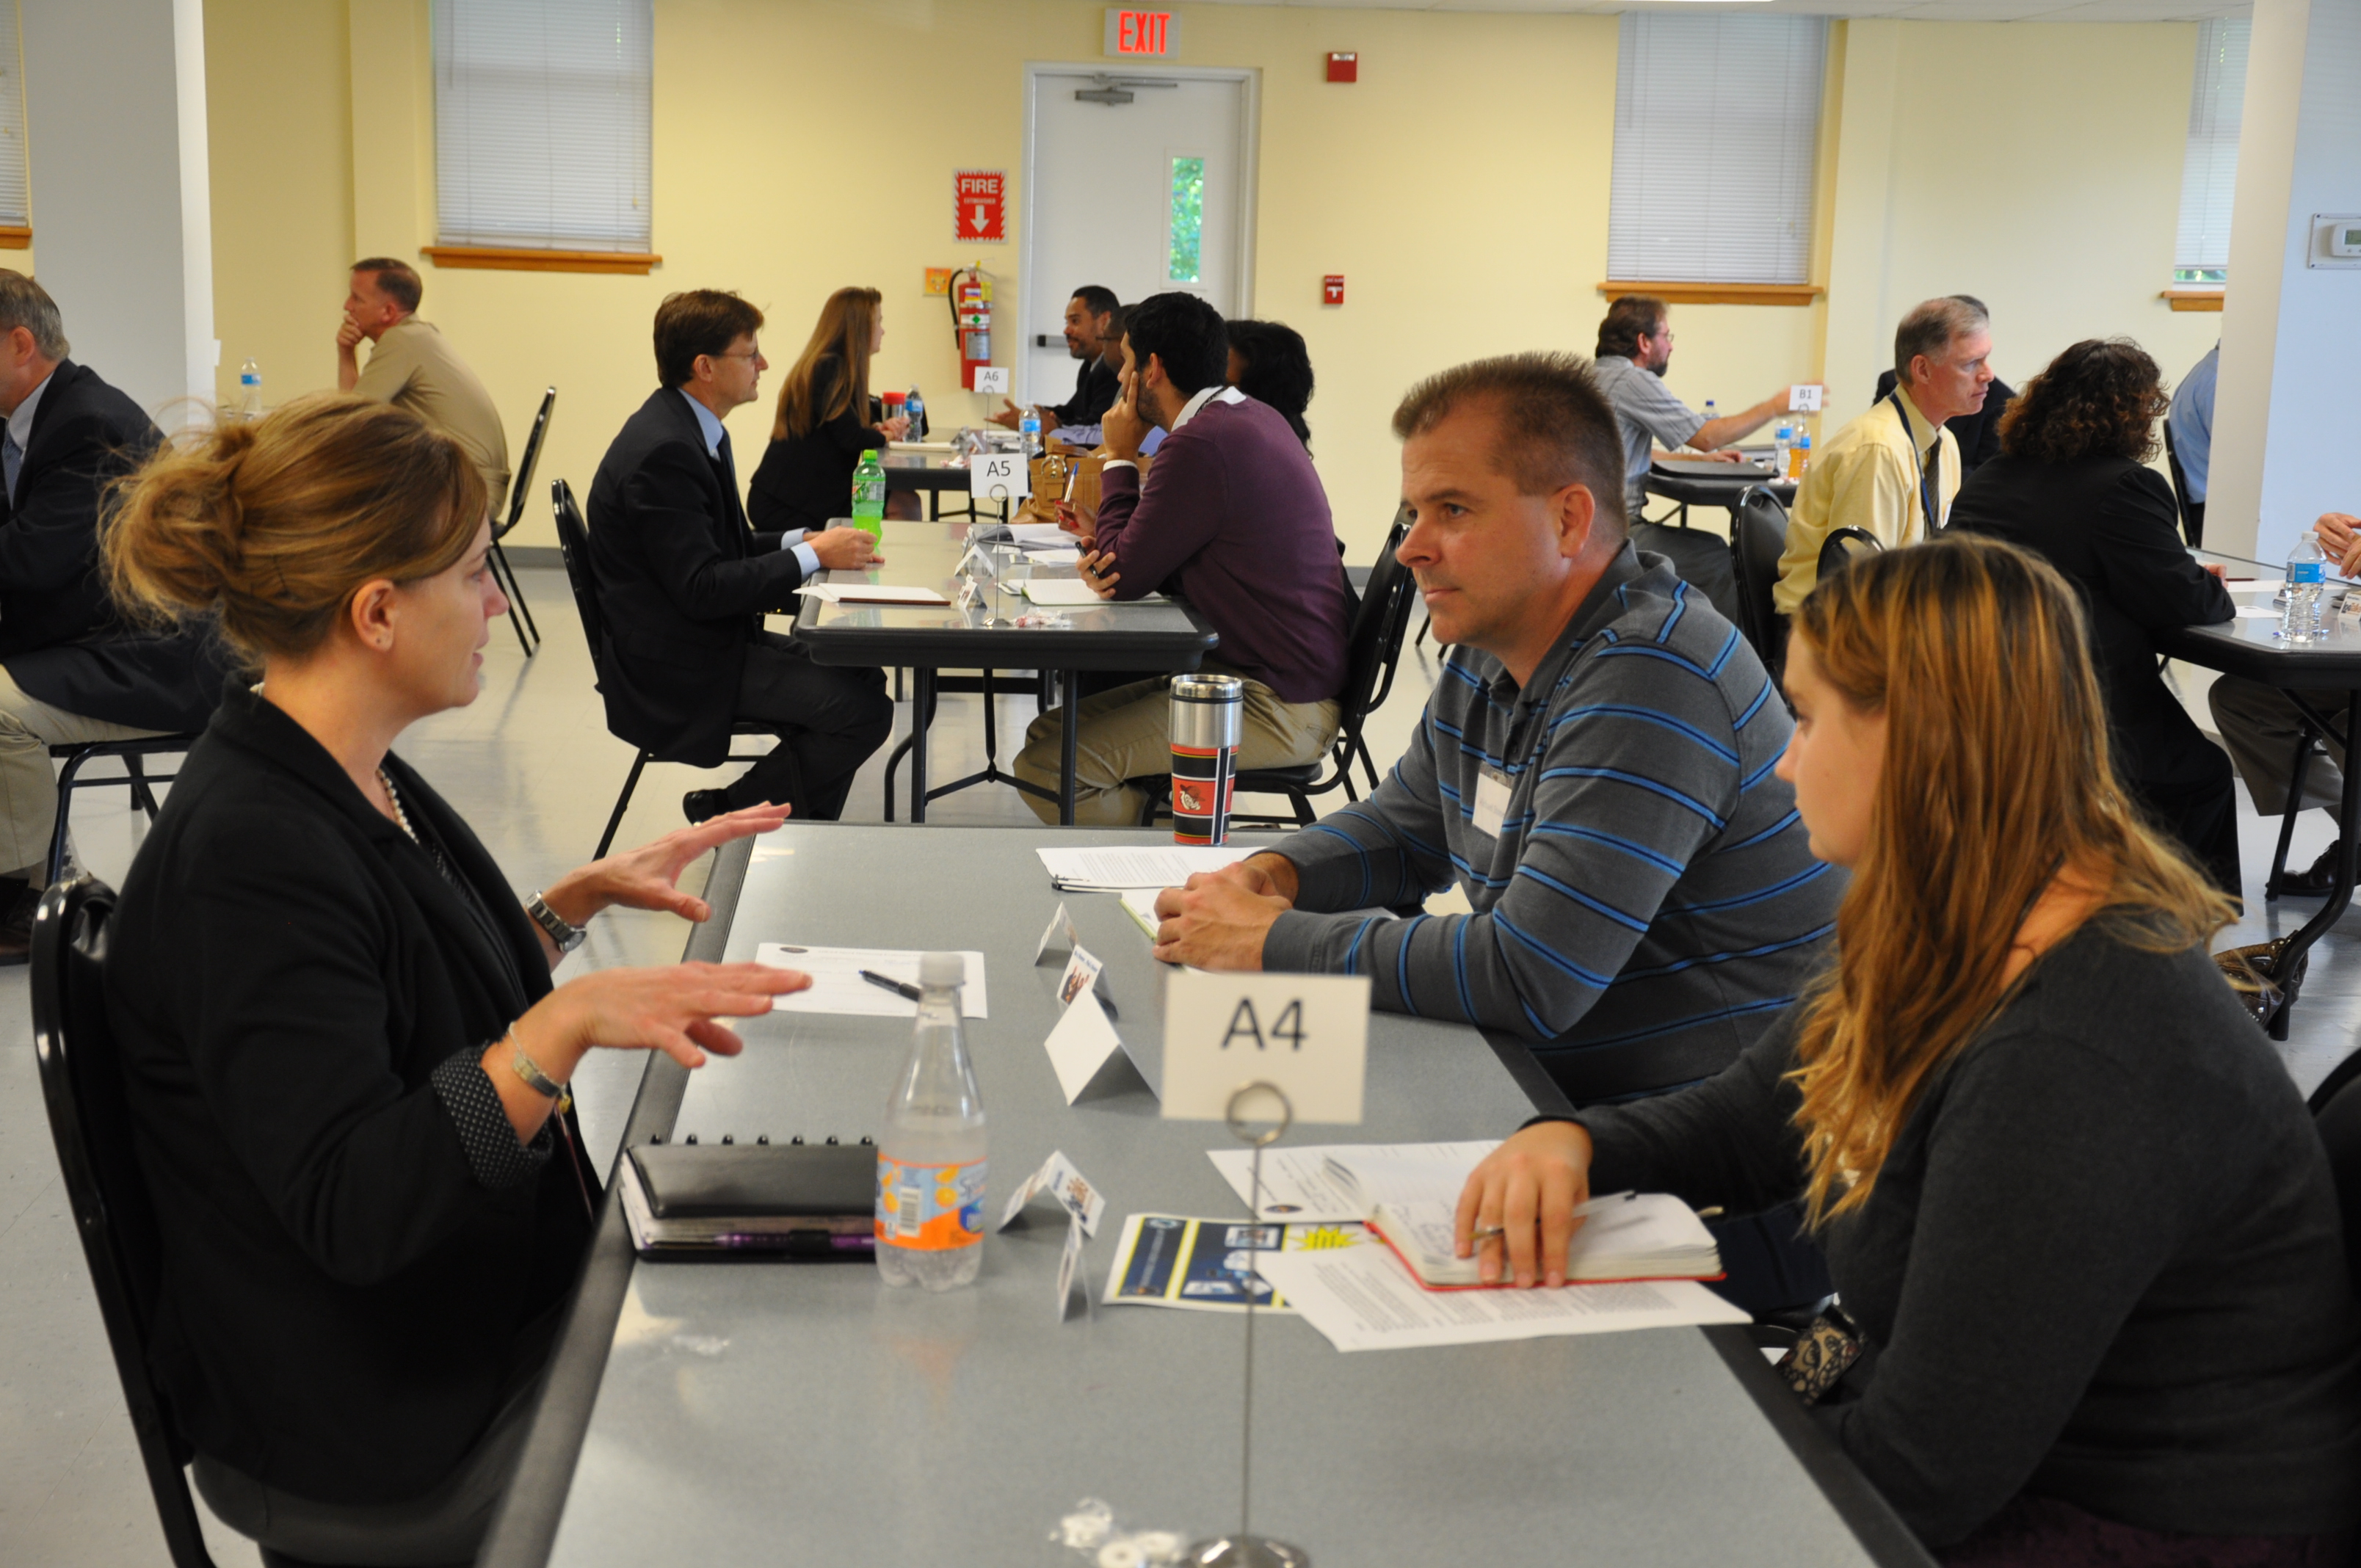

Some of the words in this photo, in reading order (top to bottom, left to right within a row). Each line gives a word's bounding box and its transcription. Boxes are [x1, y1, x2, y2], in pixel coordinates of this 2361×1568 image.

[1118, 11, 1171, 54] EXIT
[961, 178, 998, 194] FIRE
[984, 371, 998, 381] A6
[1799, 389, 1811, 399] B1
[987, 460, 1011, 476] A5
[1221, 996, 1307, 1050] A4
